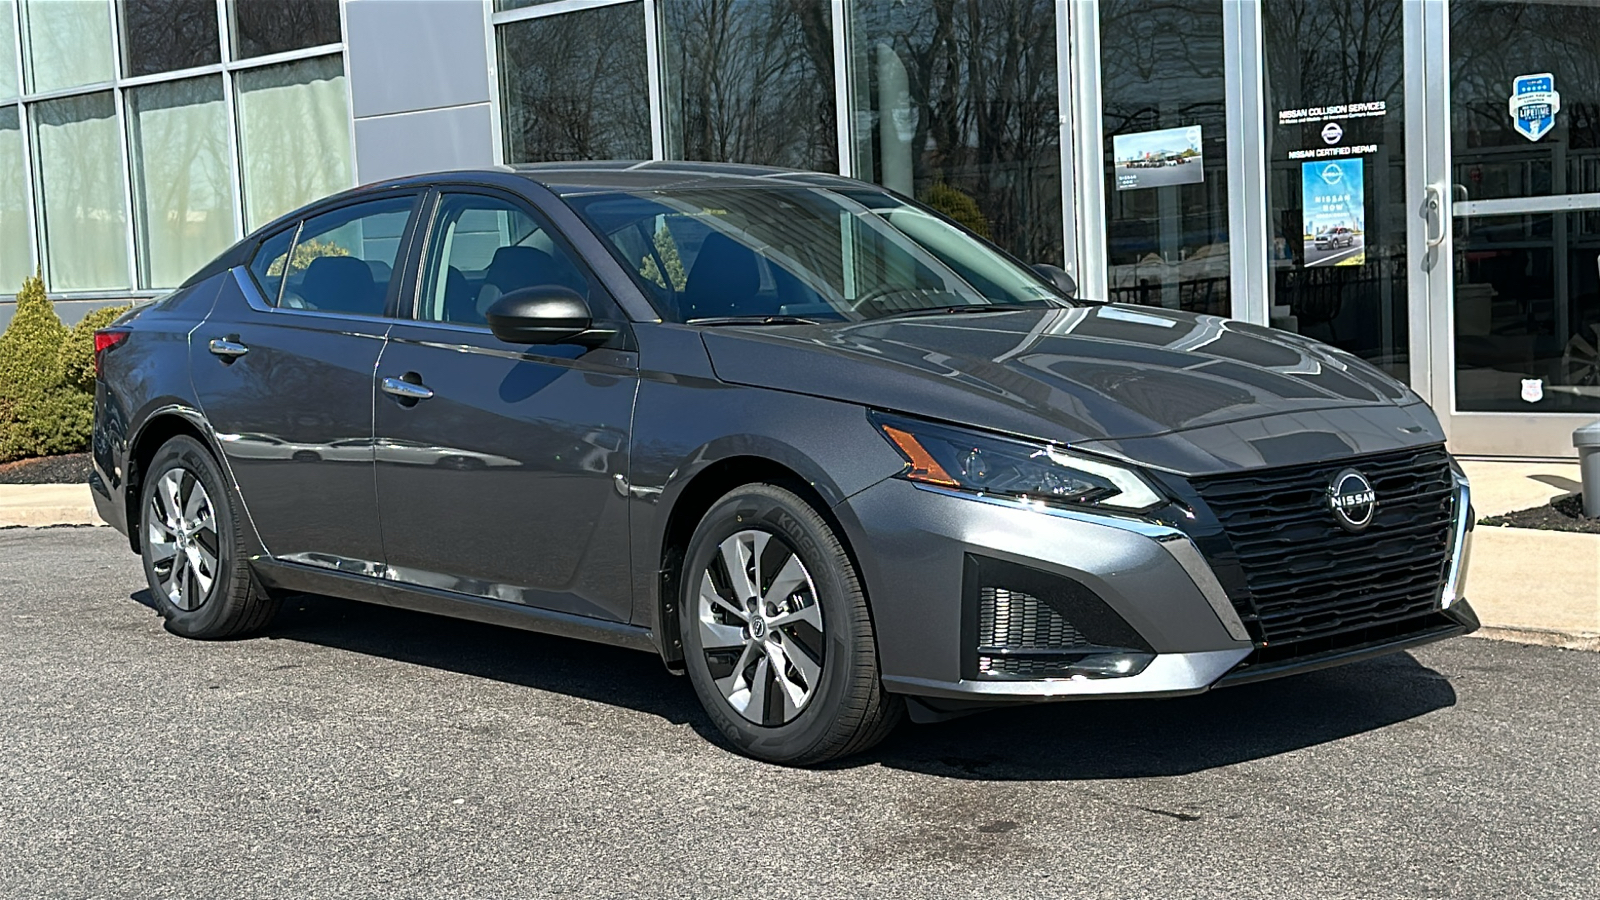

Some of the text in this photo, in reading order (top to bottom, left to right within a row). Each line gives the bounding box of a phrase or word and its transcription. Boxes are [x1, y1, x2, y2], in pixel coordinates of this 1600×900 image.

[1279, 101, 1385, 119] NISSAN COLLISION SERVICES
[1520, 107, 1550, 118] LIFETIME
[1288, 145, 1377, 159] NISSAN CERTIFIED REPAIR
[1322, 204, 1343, 212] NOW
[1331, 491, 1375, 508] NISSAN
